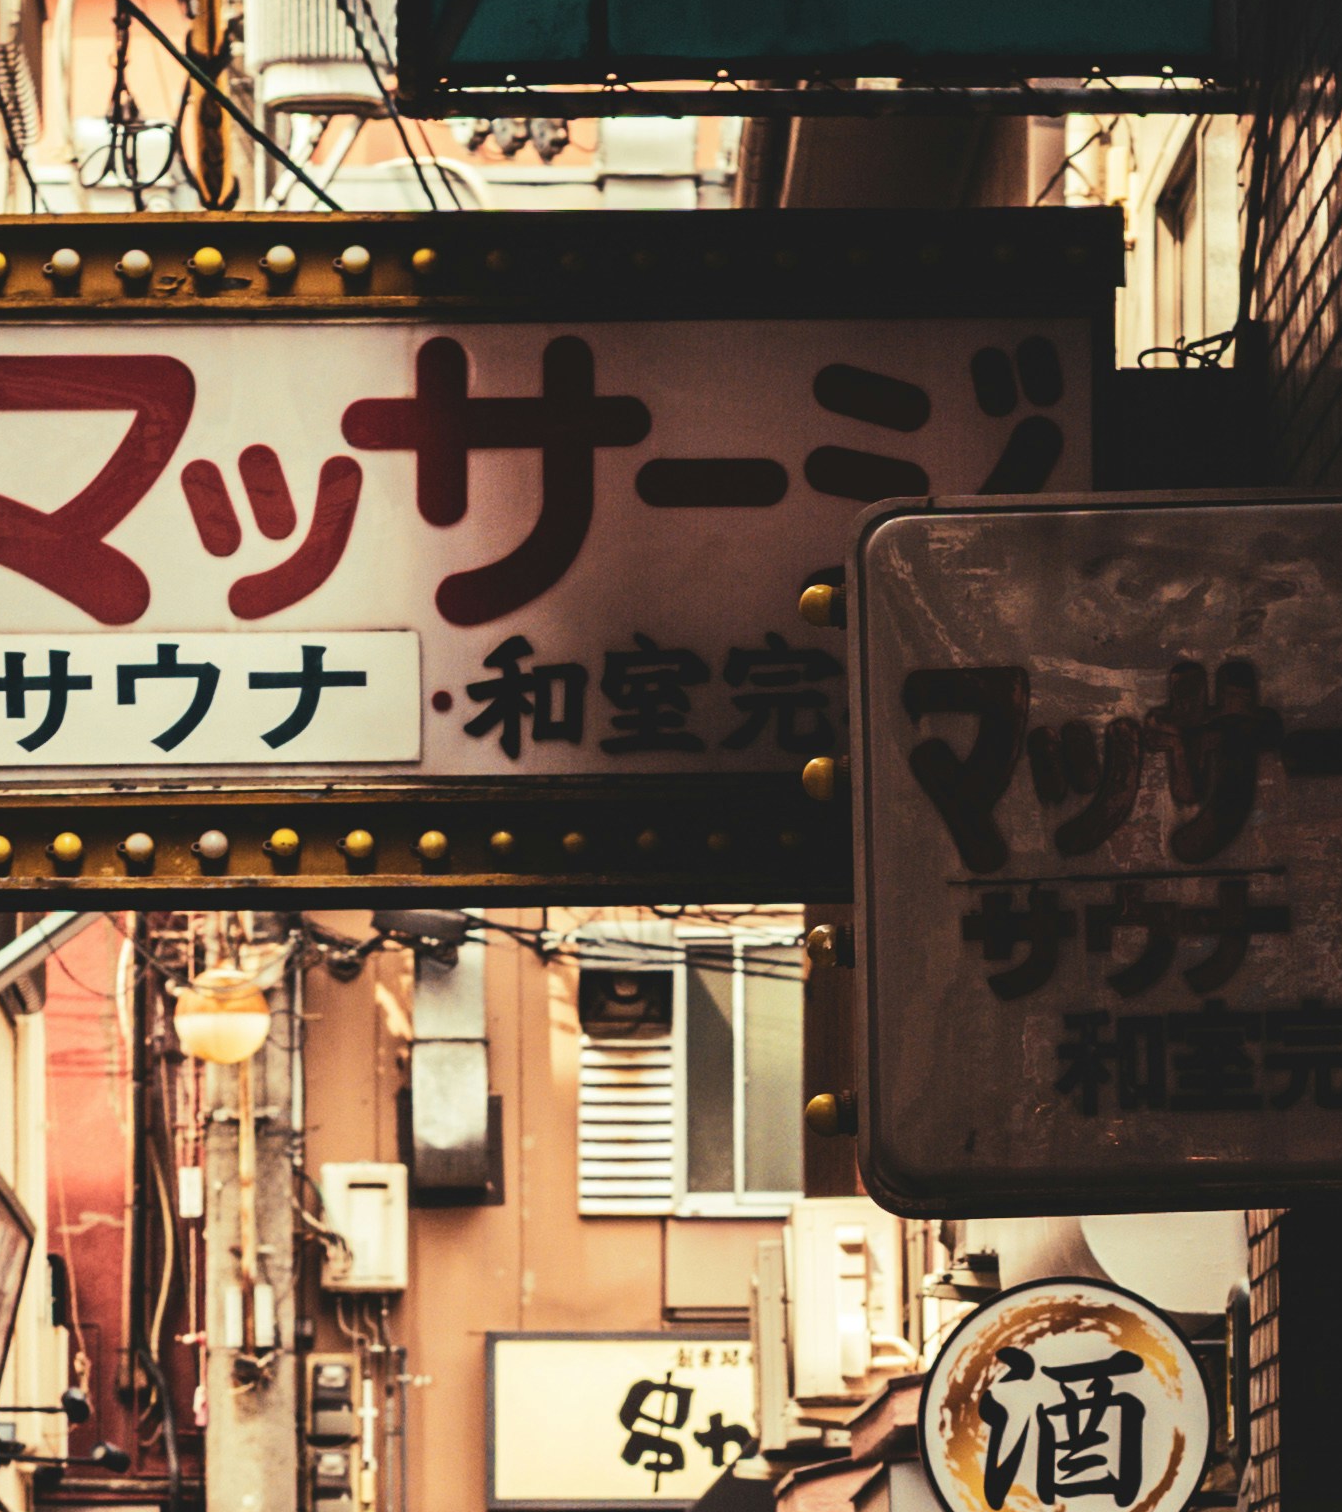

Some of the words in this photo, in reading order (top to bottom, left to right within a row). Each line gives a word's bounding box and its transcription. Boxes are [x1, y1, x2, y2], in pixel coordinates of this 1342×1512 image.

[961, 881, 1292, 1001] サウナ
[978, 1345, 1146, 1512] 酒
